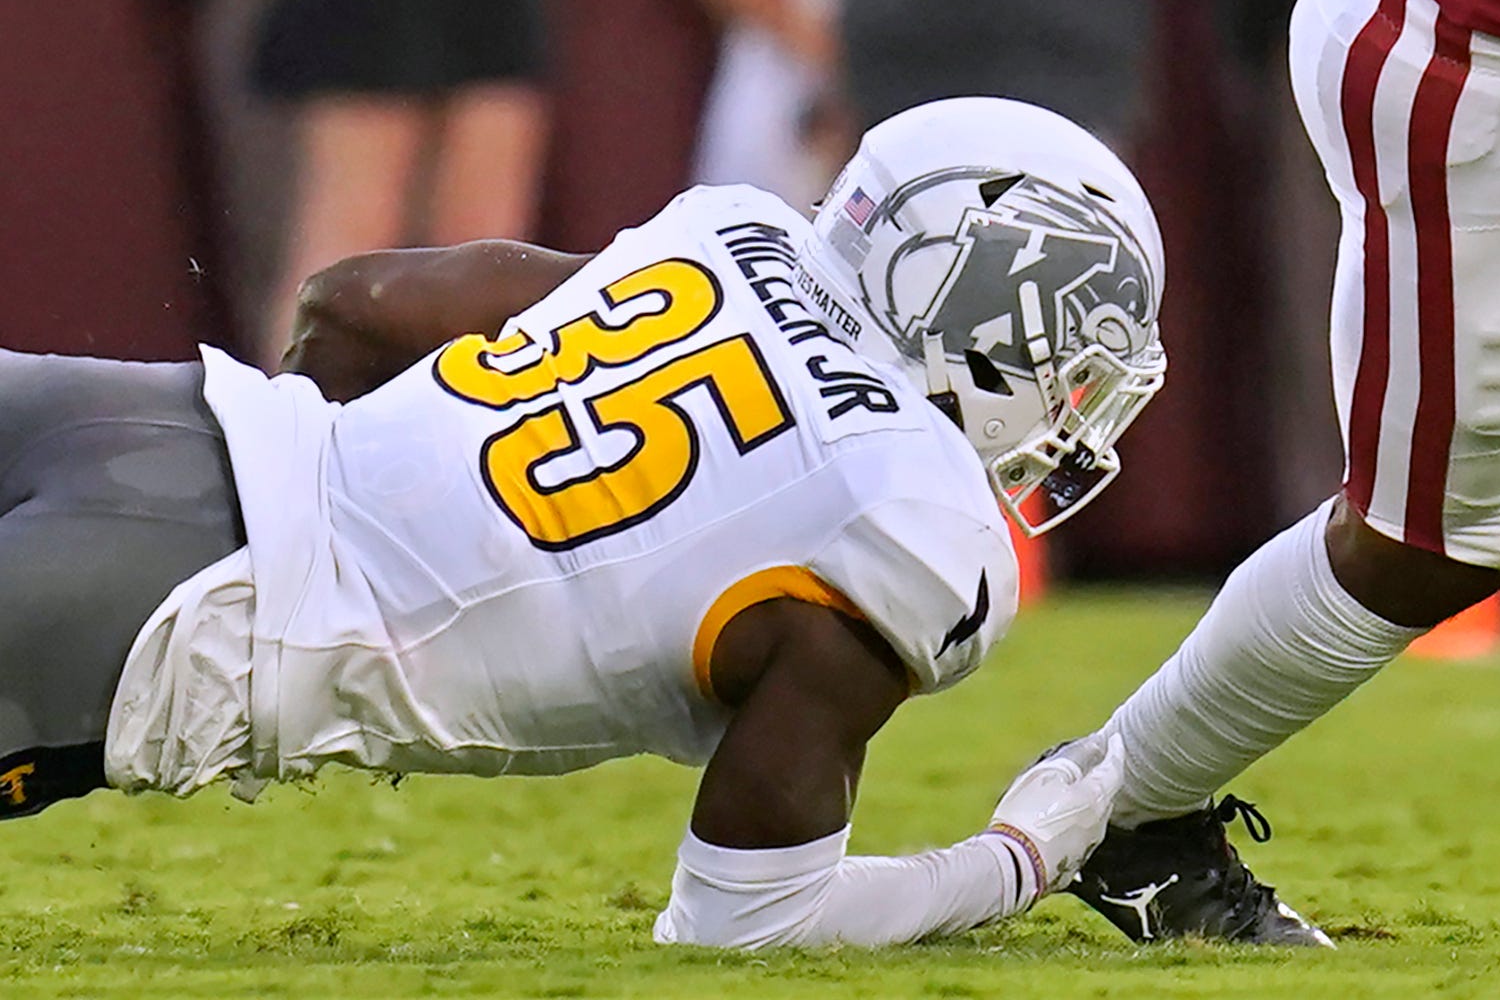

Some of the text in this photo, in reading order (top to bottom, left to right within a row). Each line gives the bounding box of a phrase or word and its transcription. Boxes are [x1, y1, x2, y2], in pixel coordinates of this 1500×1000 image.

[810, 281, 862, 342] MATTER
[433, 256, 797, 552] 35
[805, 354, 900, 420] JR
